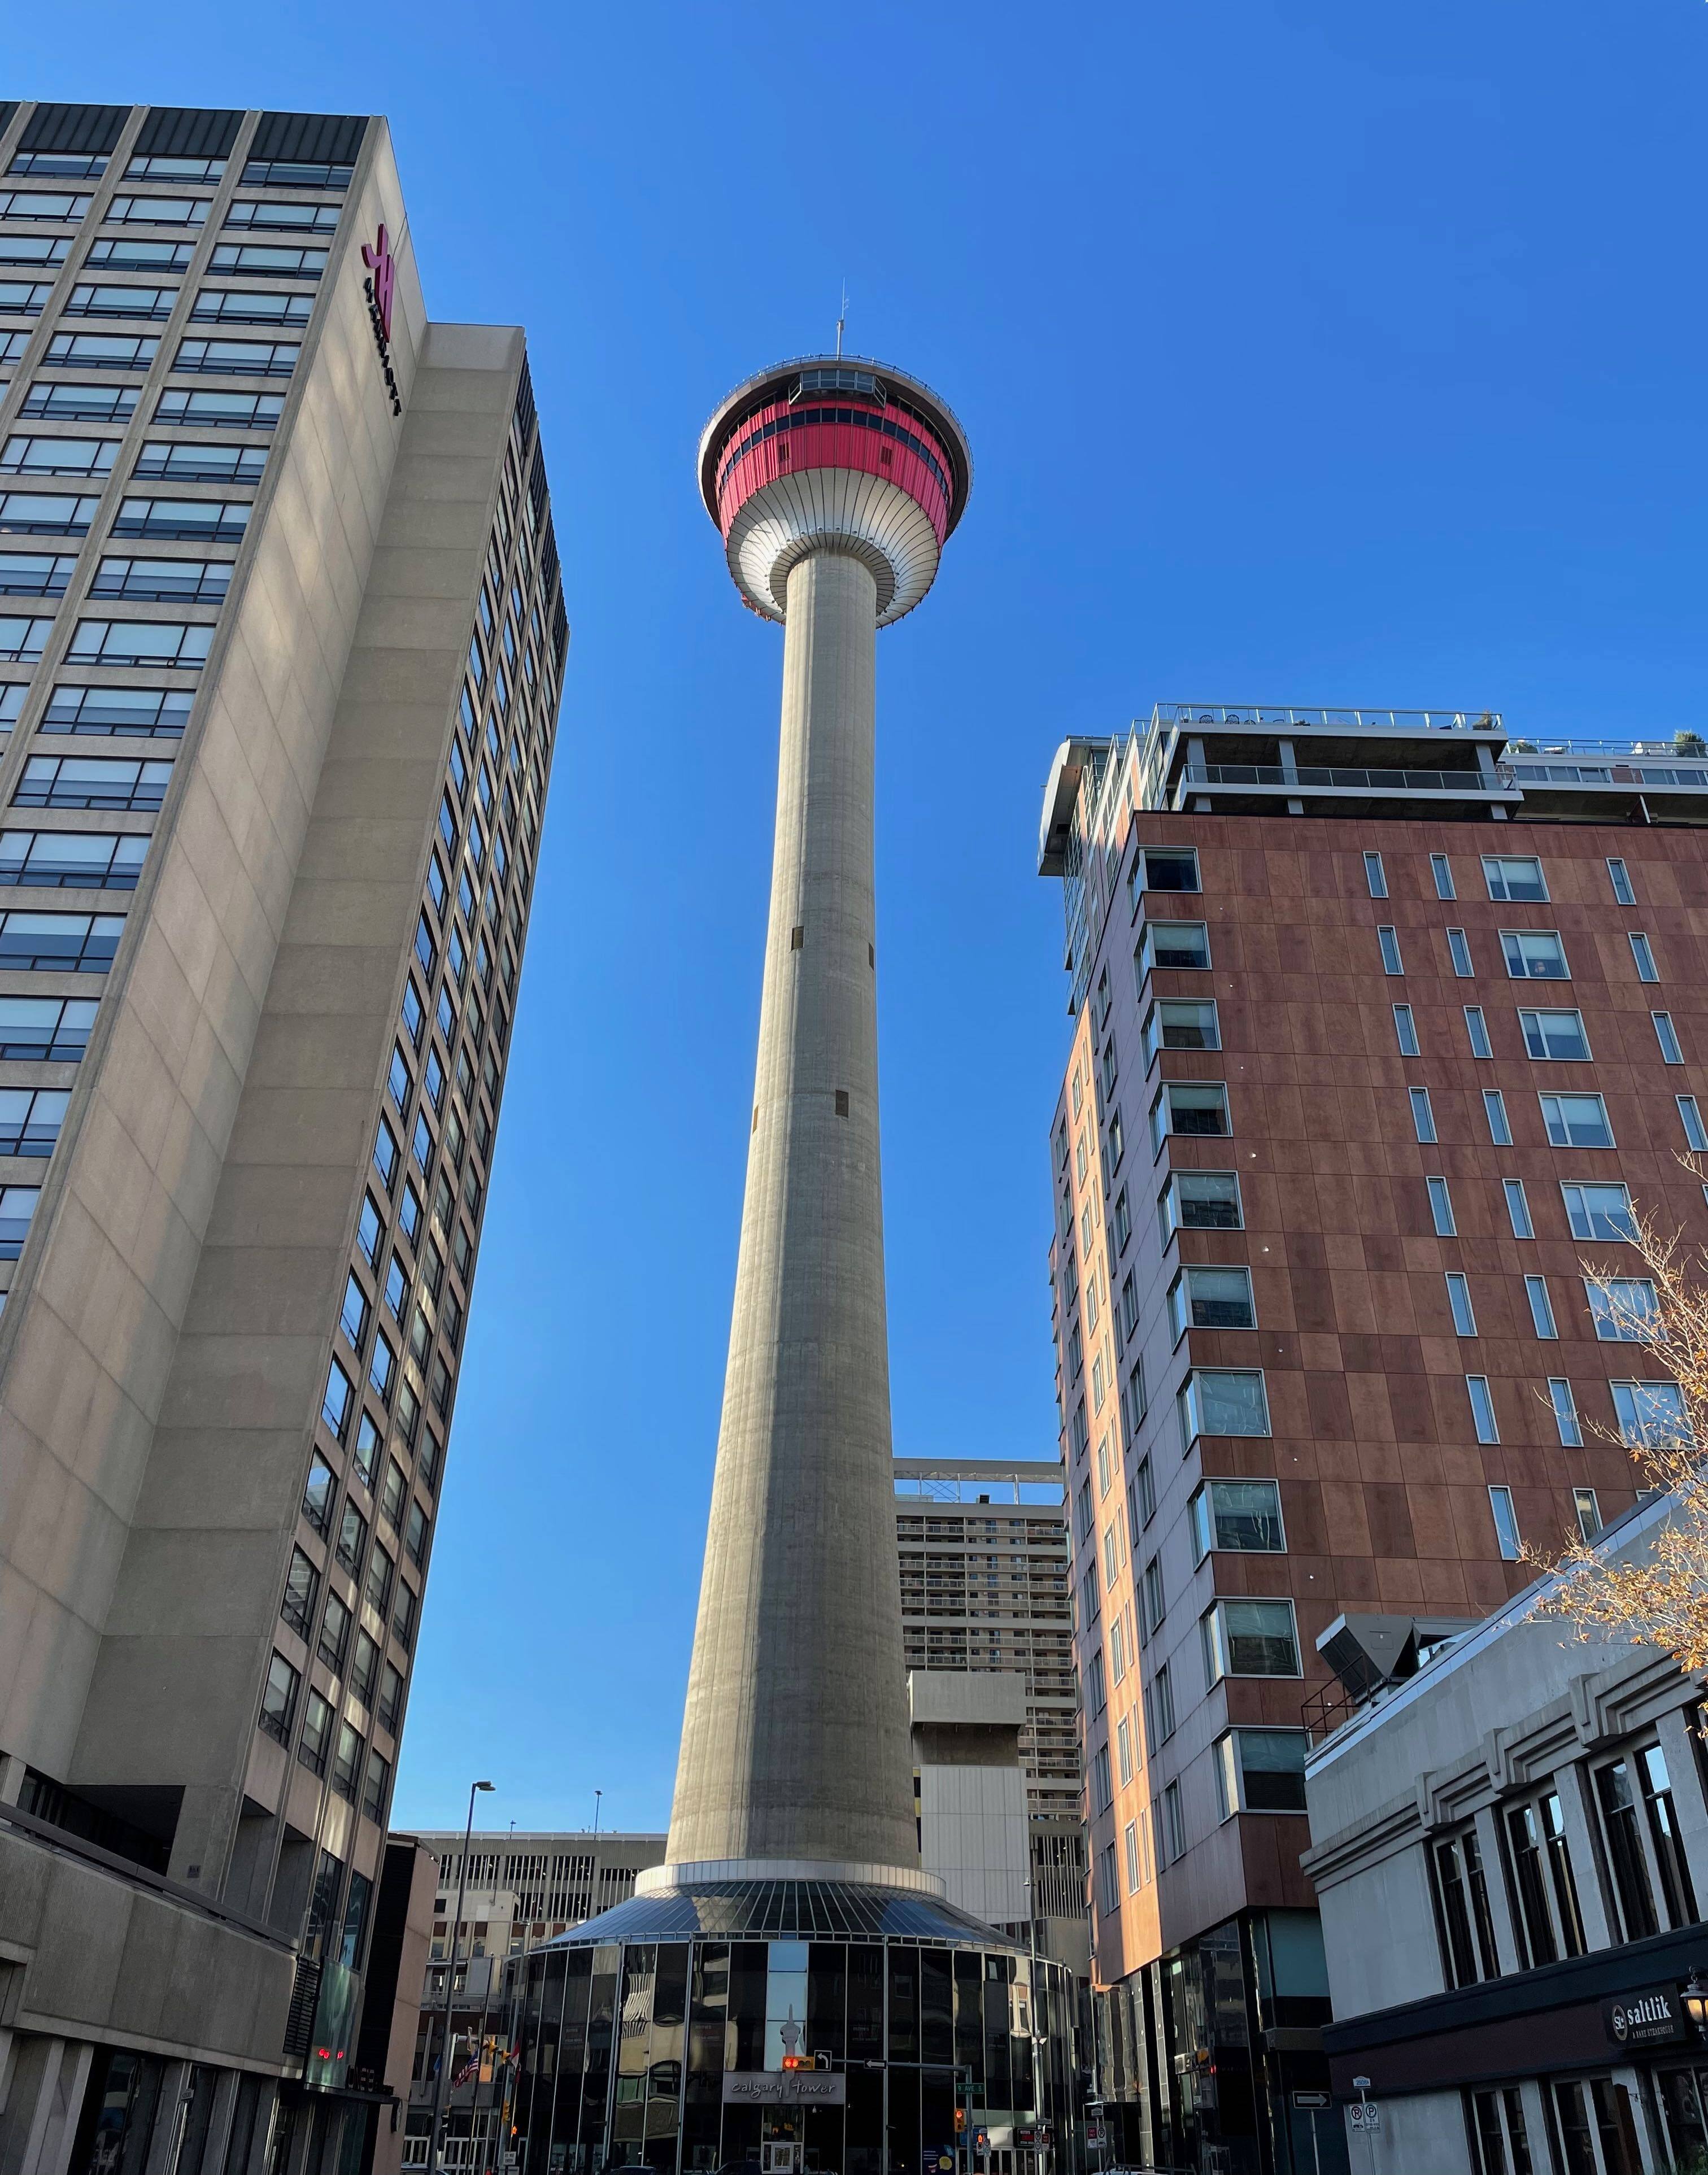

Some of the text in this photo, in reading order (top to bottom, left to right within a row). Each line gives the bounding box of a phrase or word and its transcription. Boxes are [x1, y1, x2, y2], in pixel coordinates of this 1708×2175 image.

[1627, 1995, 1672, 2025] saltlik
[1646, 2025, 1674, 2037] STEAKHOUSE
[731, 2080, 835, 2098] calgary tower
